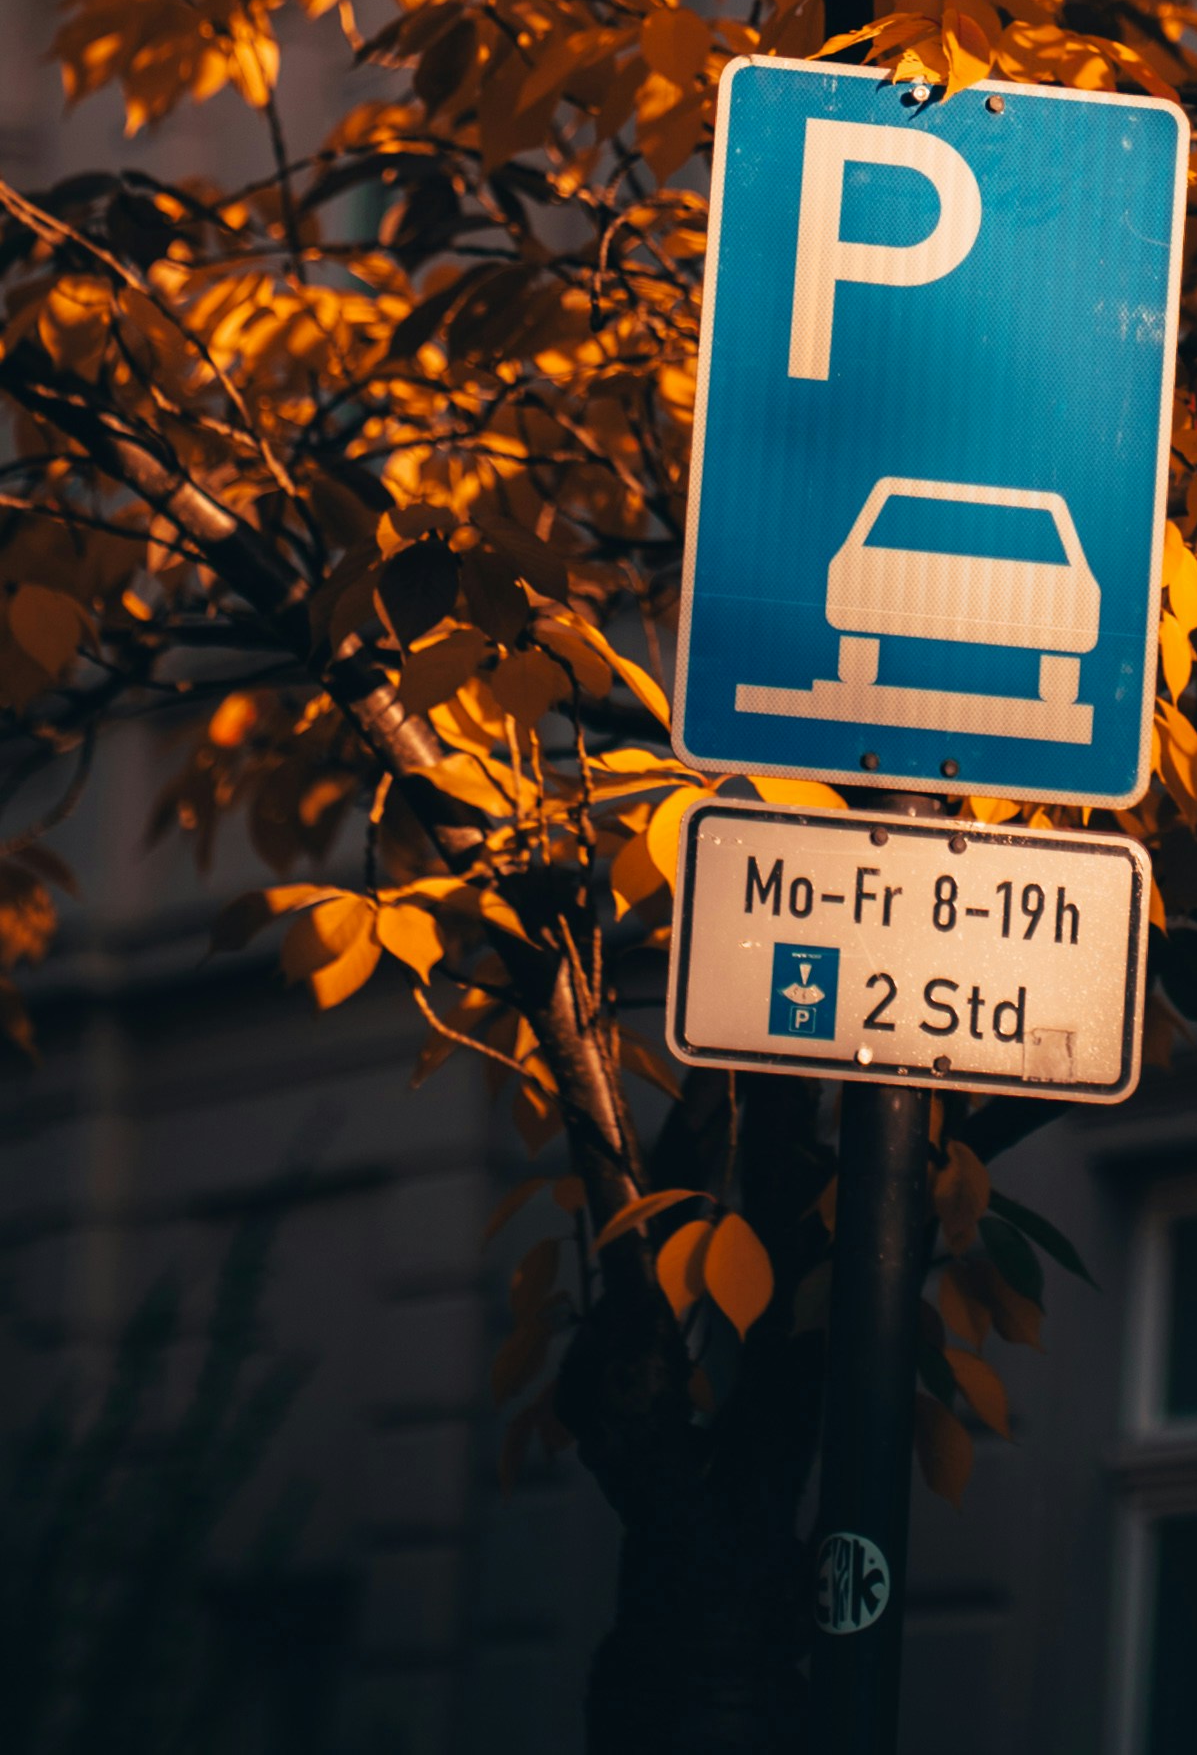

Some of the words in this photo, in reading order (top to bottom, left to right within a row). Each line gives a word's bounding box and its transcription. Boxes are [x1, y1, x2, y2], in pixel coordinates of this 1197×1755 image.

[788, 117, 982, 381] P
[744, 855, 904, 927] Mo-Fr
[932, 874, 1080, 945] 8-19h
[795, 1009, 810, 1029] P
[863, 972, 898, 1032] 2
[919, 977, 1027, 1044] Std
